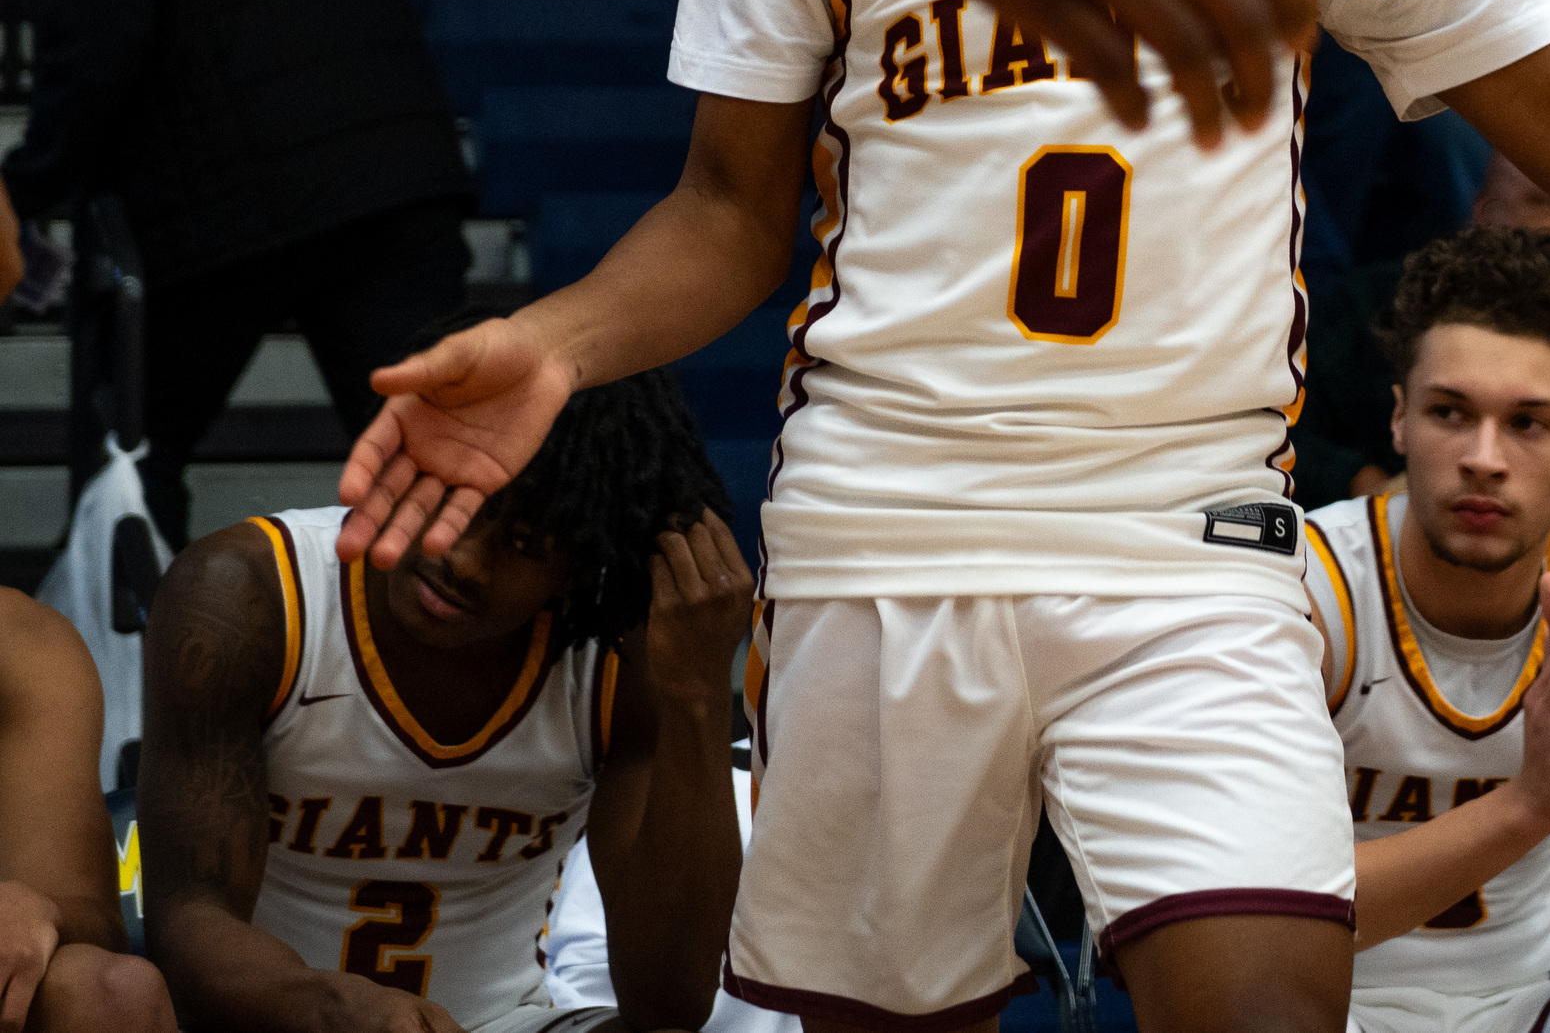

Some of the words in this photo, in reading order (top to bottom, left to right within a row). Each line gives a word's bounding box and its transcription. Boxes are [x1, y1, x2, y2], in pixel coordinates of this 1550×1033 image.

[1007, 144, 1133, 345] 0
[1275, 517, 1286, 538] S
[340, 878, 442, 999] 2
